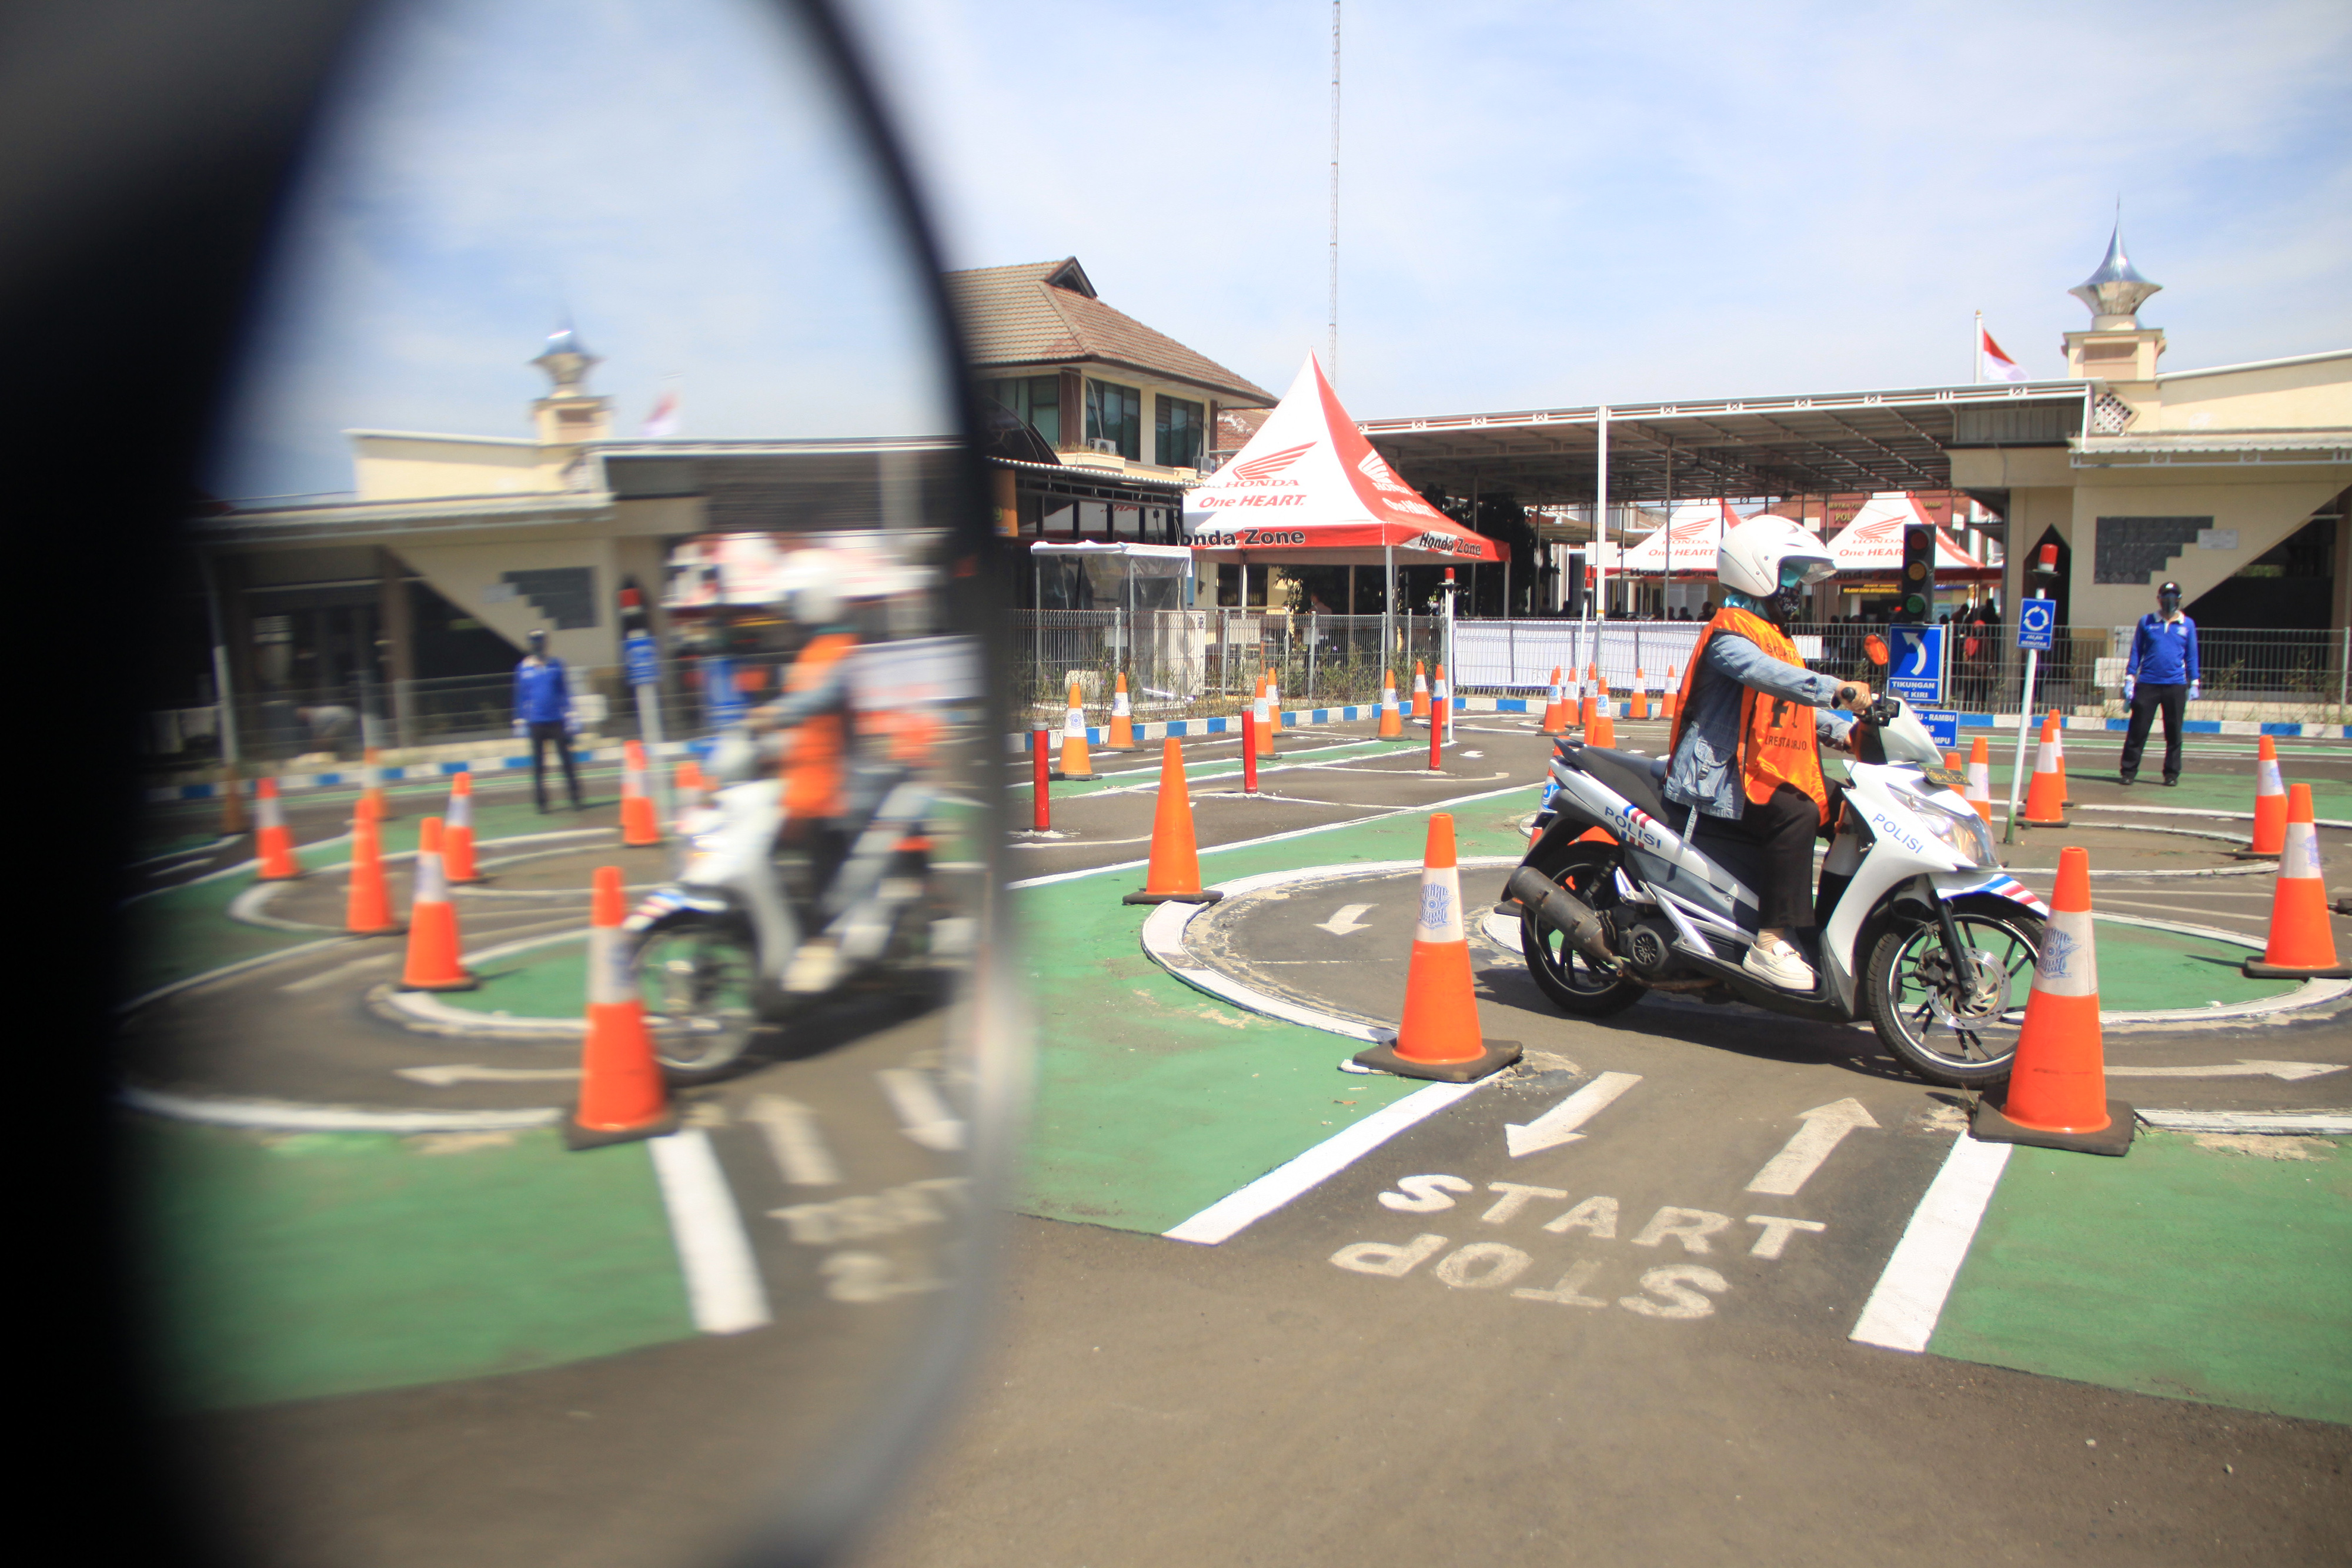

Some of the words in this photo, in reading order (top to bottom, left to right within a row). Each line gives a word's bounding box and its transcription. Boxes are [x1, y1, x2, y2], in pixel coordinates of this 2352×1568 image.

[1224, 479, 1300, 487] HONDA
[1372, 482, 1413, 496] HONDA
[1199, 496, 1236, 508] One
[1238, 494, 1307, 507] HEART.
[1182, 530, 1236, 546] onda
[1243, 529, 1305, 546] Zone
[1419, 531, 1454, 551] Honda
[1456, 537, 1482, 556] Zone
[1929, 714, 1955, 722] RAMBU
[1605, 806, 1661, 849] POLISI
[1872, 813, 1923, 854] POLISI
[1378, 1174, 1827, 1259] START
[1329, 1233, 1733, 1319] STOP
